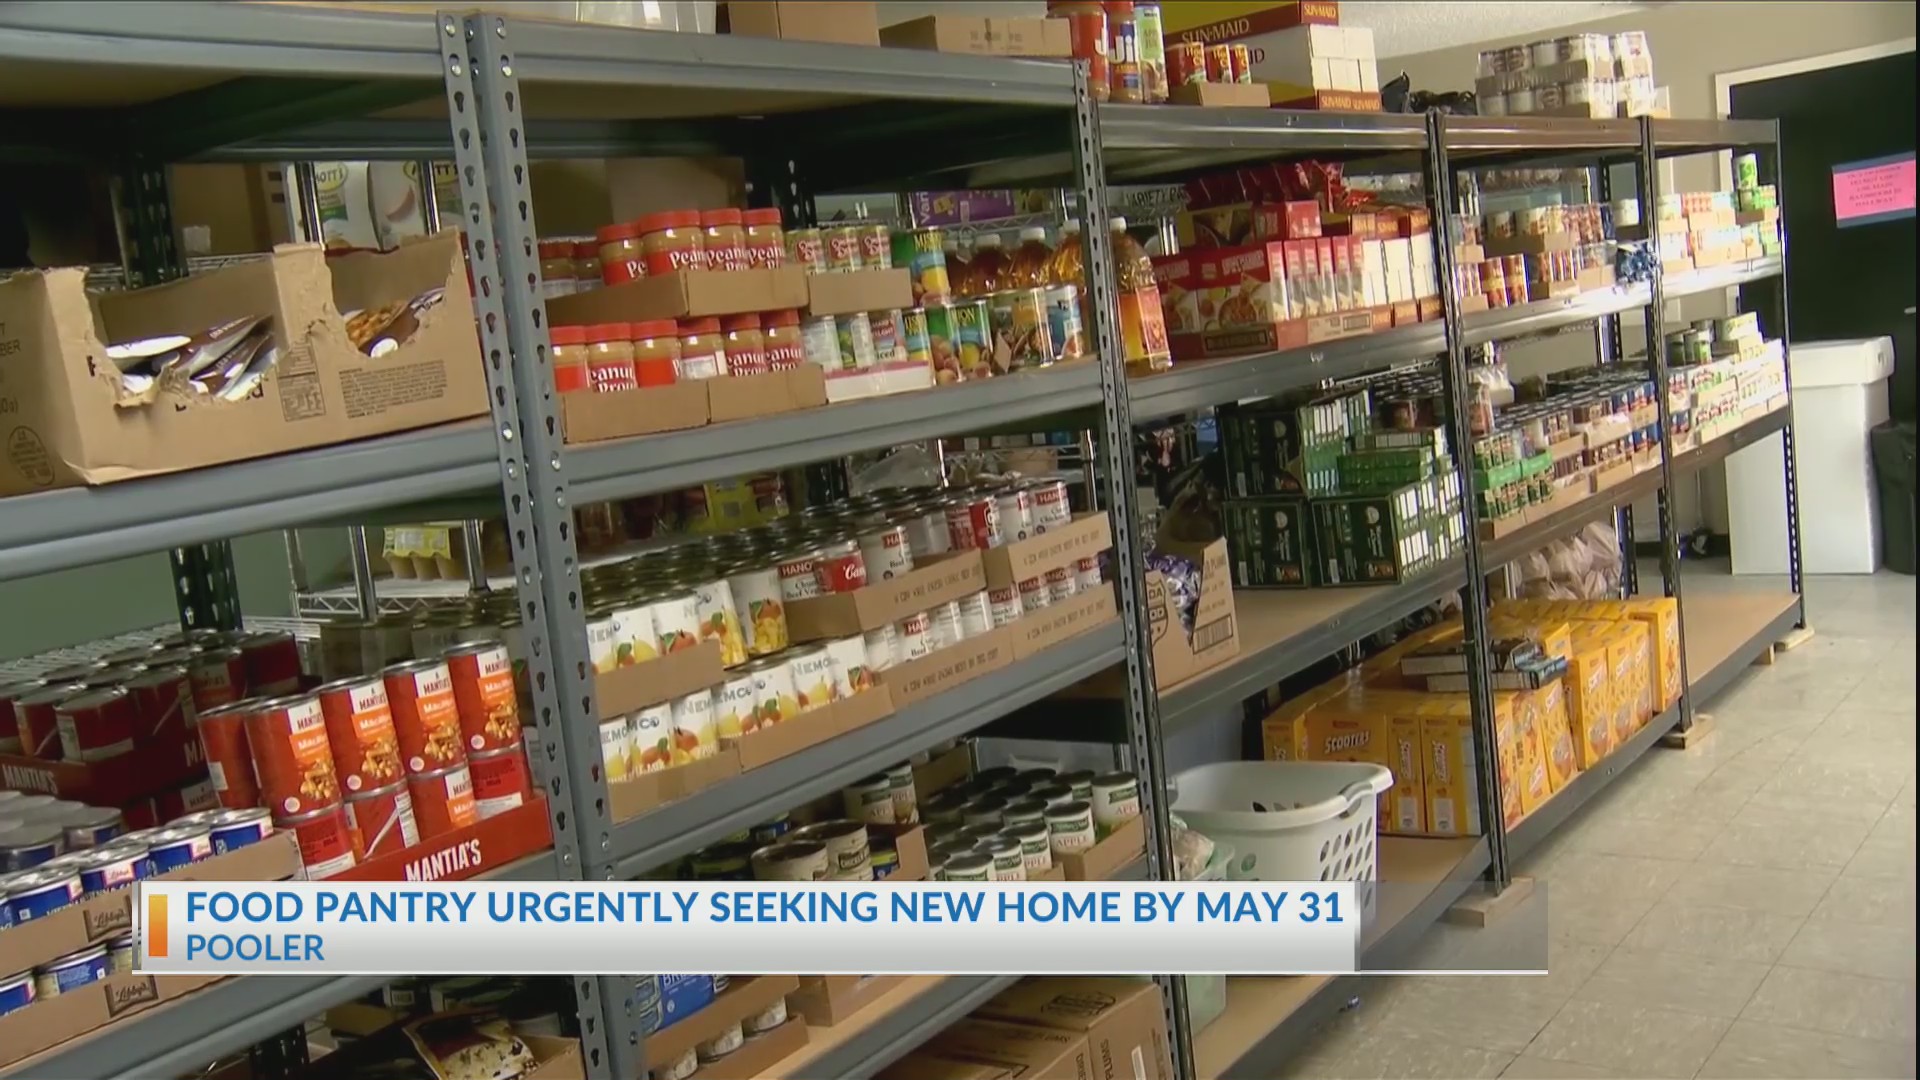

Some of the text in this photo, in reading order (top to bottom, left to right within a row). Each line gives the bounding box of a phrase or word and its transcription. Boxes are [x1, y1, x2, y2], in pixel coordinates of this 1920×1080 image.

[1324, 731, 1370, 754] SCOOTERS
[2, 763, 58, 795] MANTIA'S
[404, 838, 482, 881] MANTIA'S
